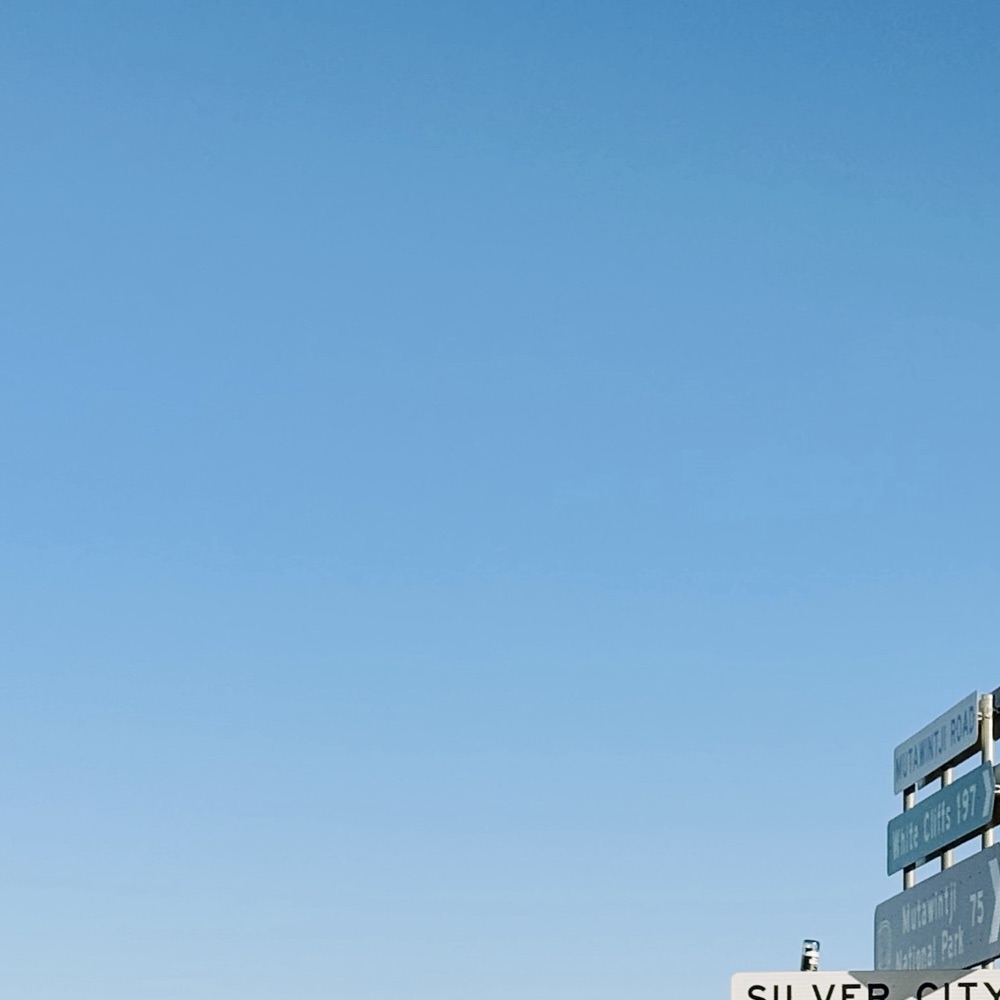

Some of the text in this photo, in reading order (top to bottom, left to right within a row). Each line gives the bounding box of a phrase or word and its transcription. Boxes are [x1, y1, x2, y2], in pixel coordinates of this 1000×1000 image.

[950, 705, 975, 746] ROAD
[892, 784, 977, 860] White Cliffs 197
[969, 890, 985, 927] 75
[895, 924, 964, 970] National Park
